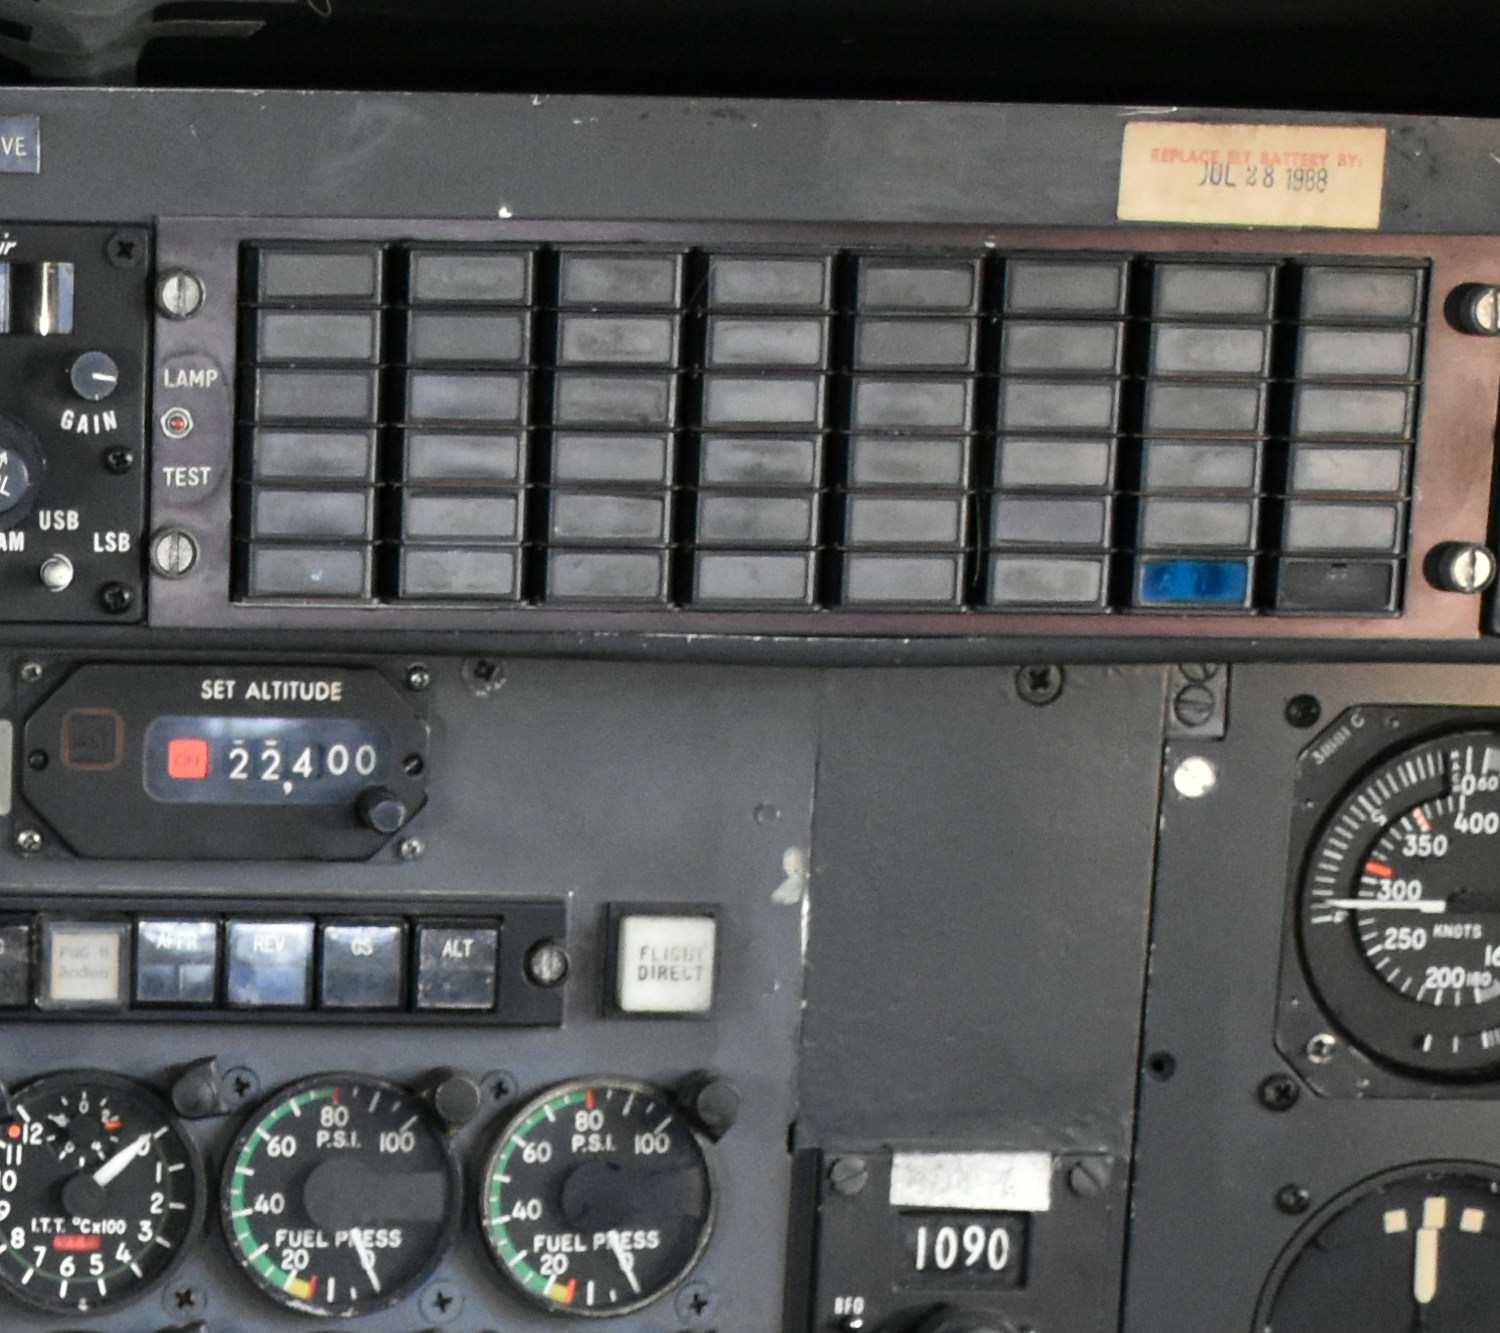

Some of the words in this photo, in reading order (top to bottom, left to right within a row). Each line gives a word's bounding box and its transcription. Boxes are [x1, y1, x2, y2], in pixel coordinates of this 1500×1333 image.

[1199, 163, 1236, 187] JUL
[163, 368, 219, 388] LAMP
[60, 409, 119, 434] GAIN
[162, 466, 212, 487] TEST
[38, 509, 80, 531] USB
[93, 531, 131, 553] LSB
[200, 679, 236, 700] SET
[244, 680, 342, 702] ALTITUDE
[1453, 812, 1500, 835] 400
[1402, 833, 1448, 857] 350
[915, 1226, 1009, 1270] 1090
